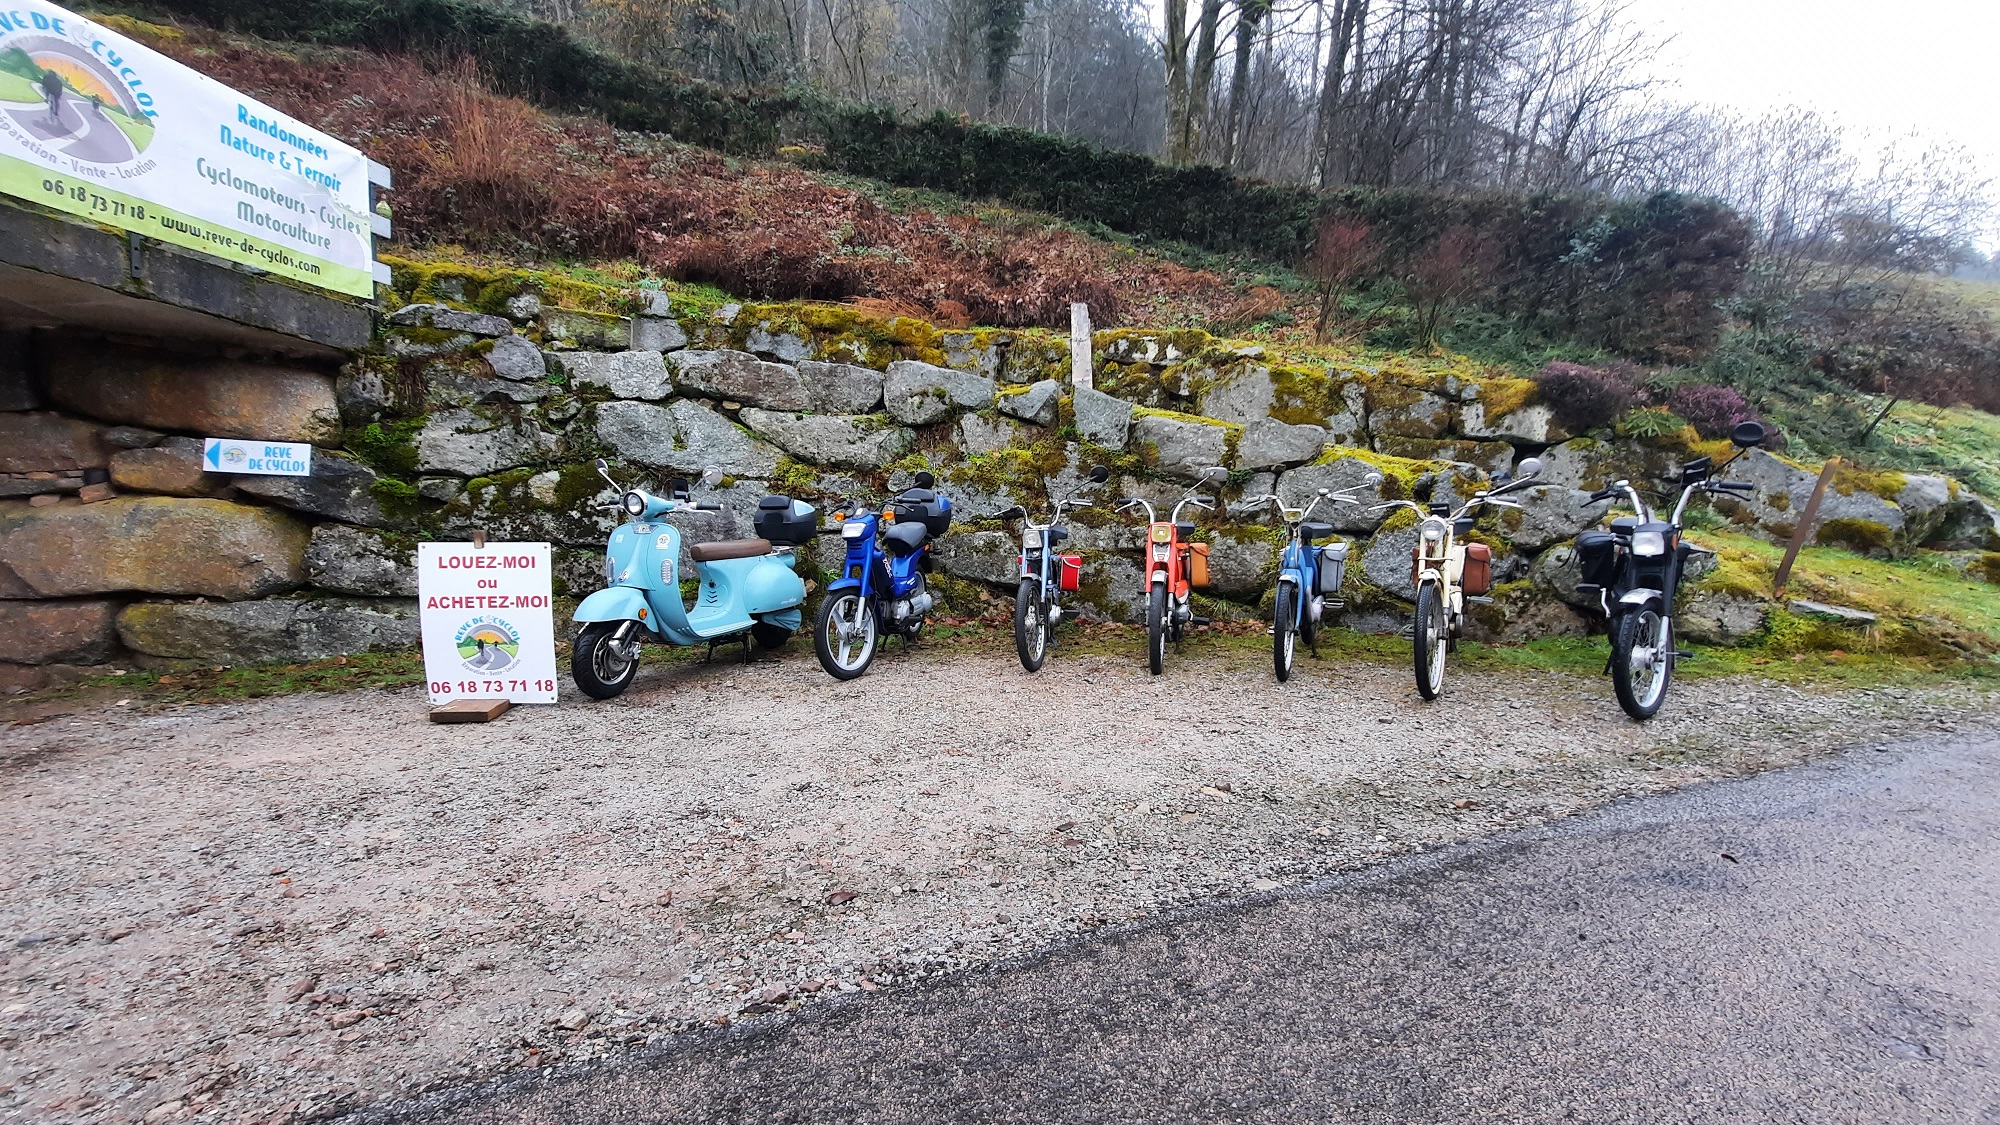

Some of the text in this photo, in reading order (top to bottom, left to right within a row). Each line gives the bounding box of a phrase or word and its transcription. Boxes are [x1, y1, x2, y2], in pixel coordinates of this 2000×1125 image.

[30, 11, 67, 36] DE
[91, 40, 159, 118] CYCLOS
[237, 103, 329, 161] Randonnées
[70, 159, 107, 179] Vente
[117, 158, 157, 179] Location
[220, 124, 342, 192] Nature & Terroir
[196, 157, 306, 215] Cyclomoteurs
[320, 205, 361, 235] Cycles
[42, 179, 65, 195] 06
[70, 186, 87, 202] 18
[90, 193, 108, 212] 73
[111, 199, 125, 216] 71
[130, 206, 145, 220] 18
[161, 214, 321, 276] www.reve-de-cyclos.com
[237, 200, 331, 250] Motoculture
[264, 446, 292, 459] REVE
[249, 458, 305, 472] DE CYCLOS
[438, 555, 536, 569] LOUEZ-MOI
[477, 578, 498, 589] ou
[427, 595, 549, 609] ACHETEZ-MOI
[454, 615, 521, 642] REVE DE CYCLOS
[505, 658, 521, 672] Location
[430, 679, 554, 694] 06 18 73 71 18
